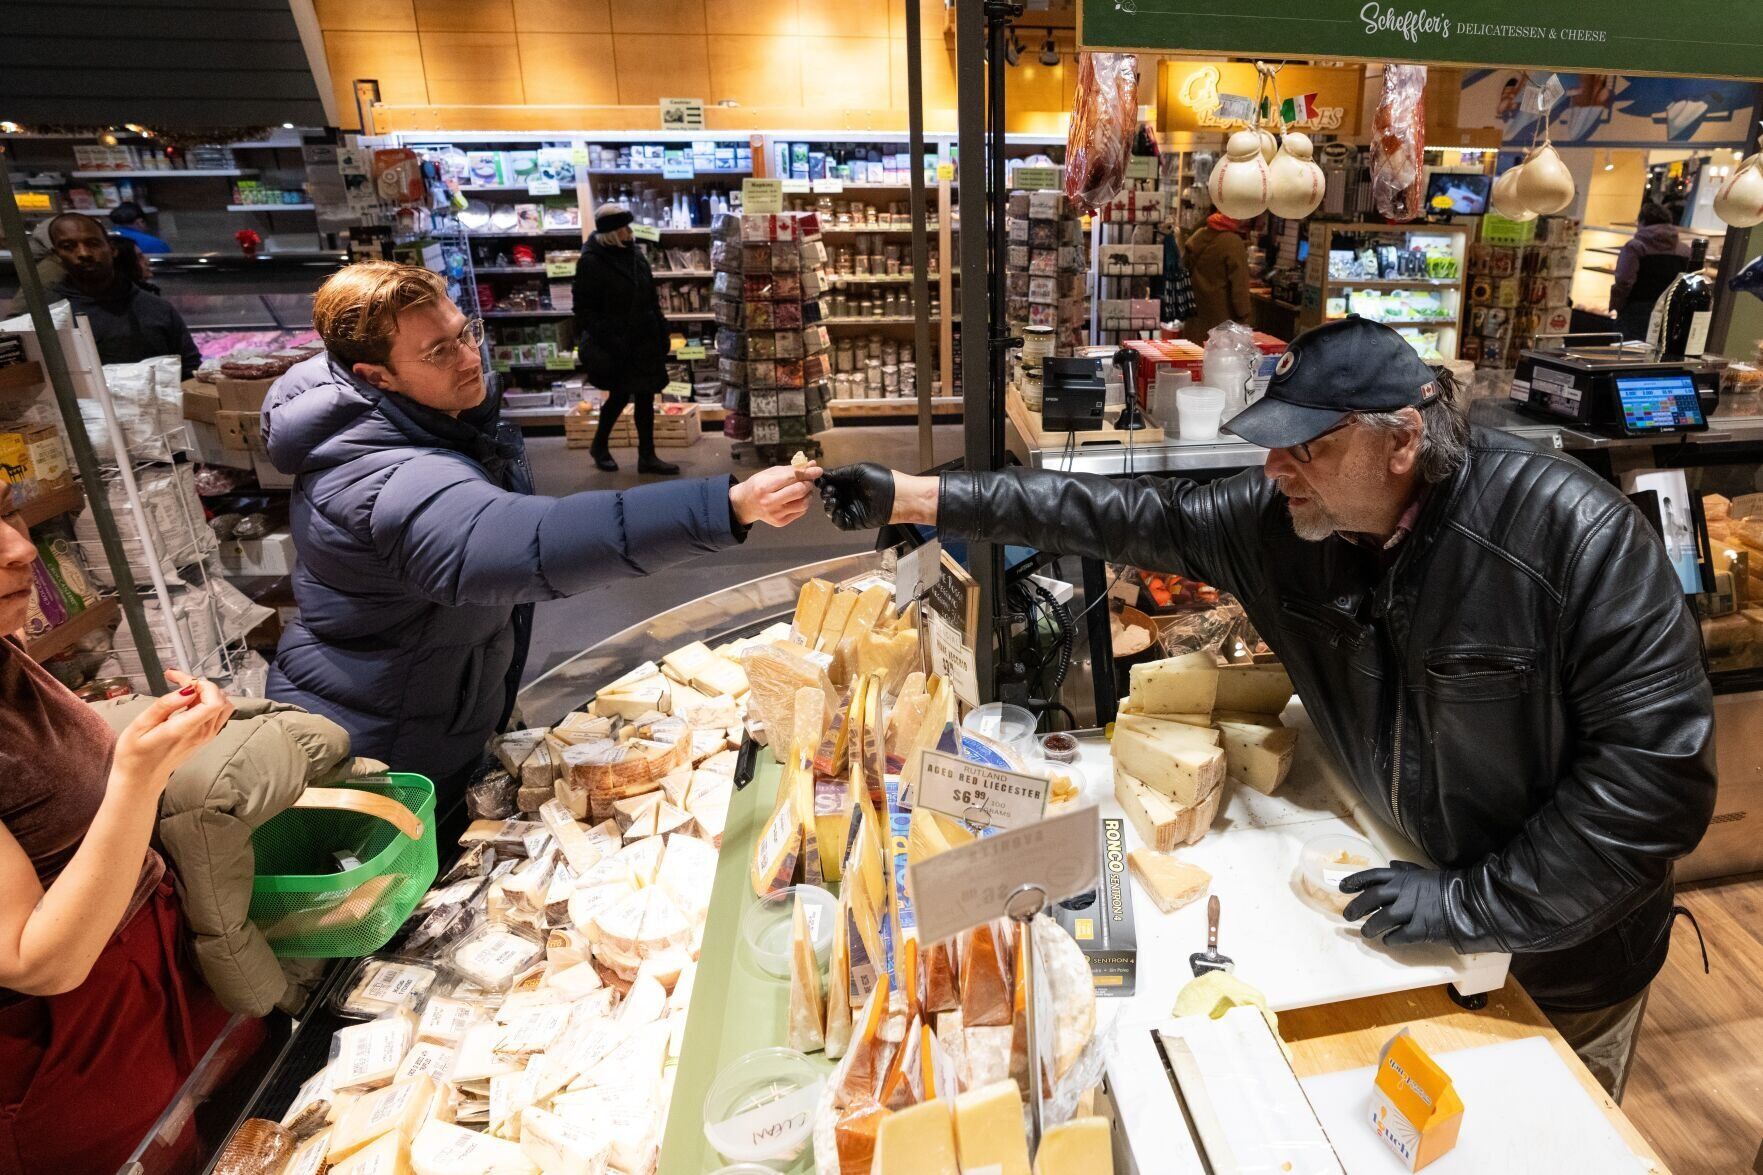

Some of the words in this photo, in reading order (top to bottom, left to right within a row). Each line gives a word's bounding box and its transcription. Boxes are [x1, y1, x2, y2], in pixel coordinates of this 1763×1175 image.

[1359, 2, 1451, 43] Scheffler's
[1456, 22, 1546, 39] DELICATESSEN
[1548, 28, 1557, 39] &
[1560, 28, 1607, 42] CHEESE
[958, 773, 978, 785] RED
[983, 779, 1041, 800] LIECESTER
[963, 765, 1008, 782] RUTLAND
[1105, 820, 1124, 872] RONCO
[1110, 873, 1123, 913] SENTRON
[1113, 913, 1122, 921] 4
[752, 1112, 807, 1145] CLEAN
